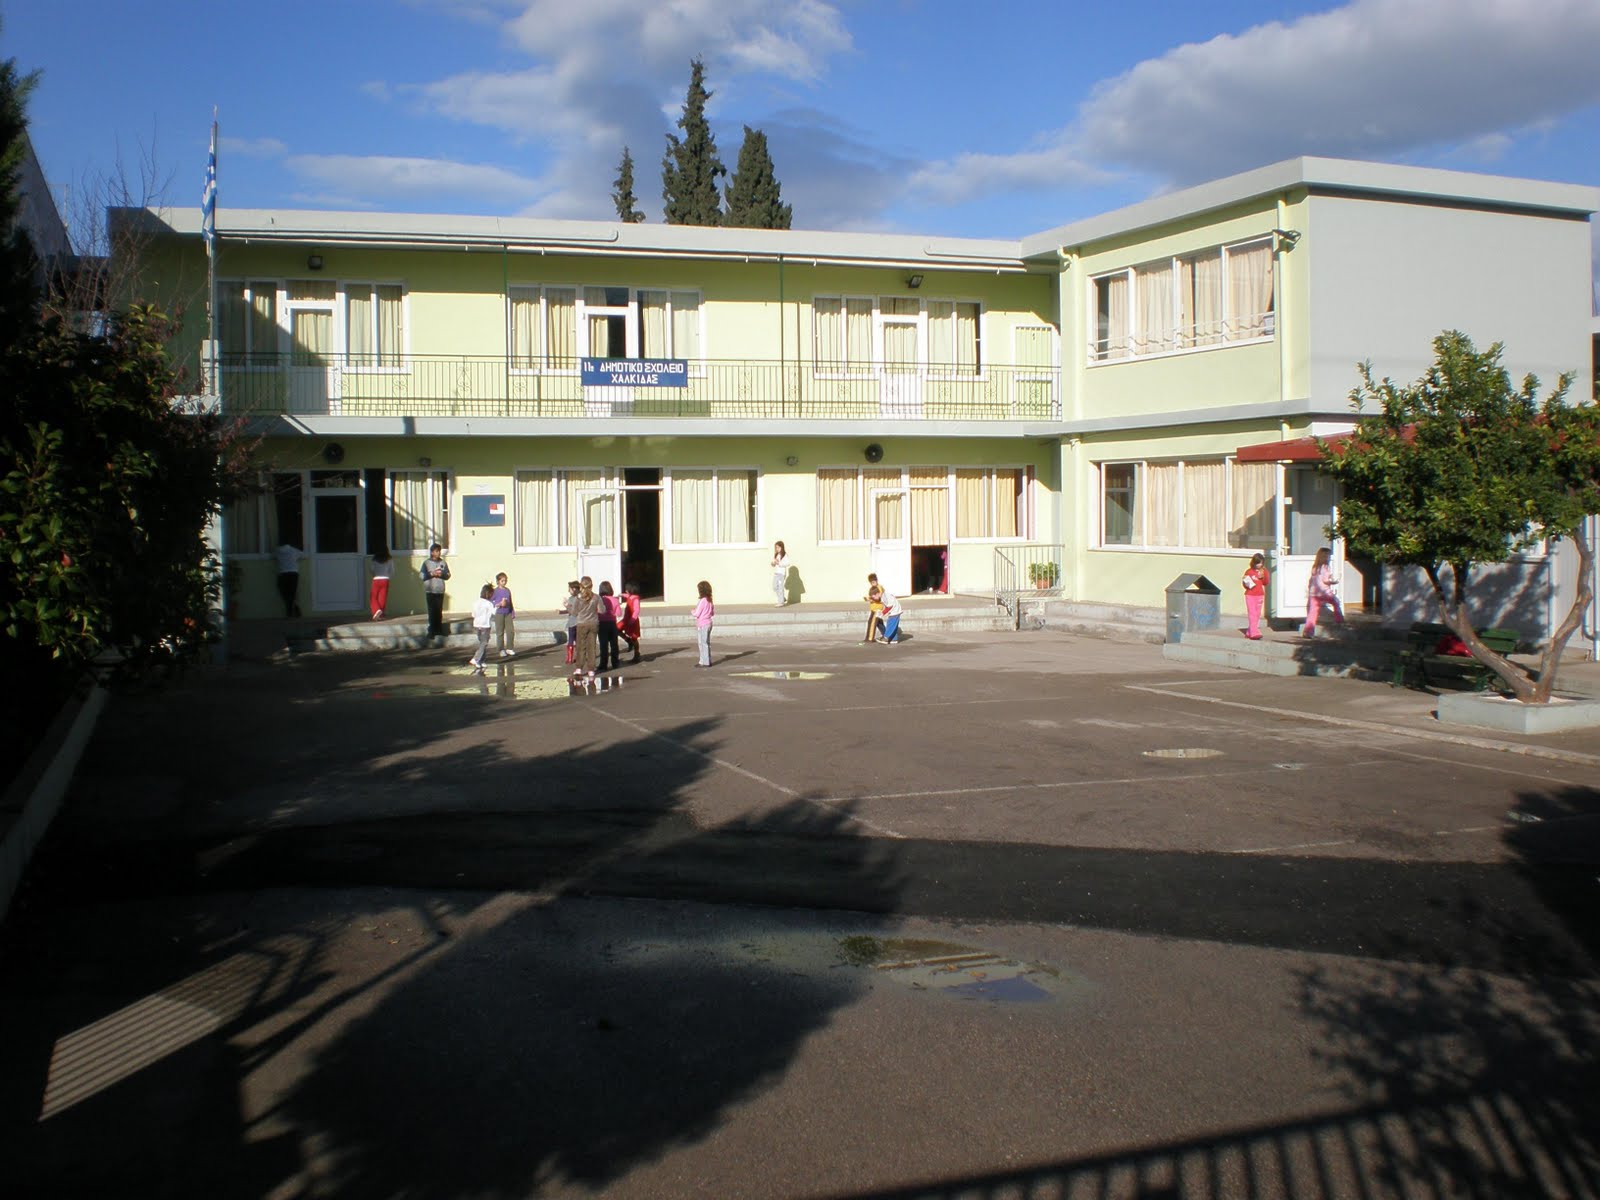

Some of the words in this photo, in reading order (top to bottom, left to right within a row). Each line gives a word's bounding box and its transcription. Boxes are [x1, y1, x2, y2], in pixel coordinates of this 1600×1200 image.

[600, 362, 643, 373] ΔΗΜΟΤΙΚΟ
[644, 363, 684, 373] ΣΧΟΛΕΙΟ
[611, 374, 658, 384] ΧΑΛΚΙΔΑΣ
